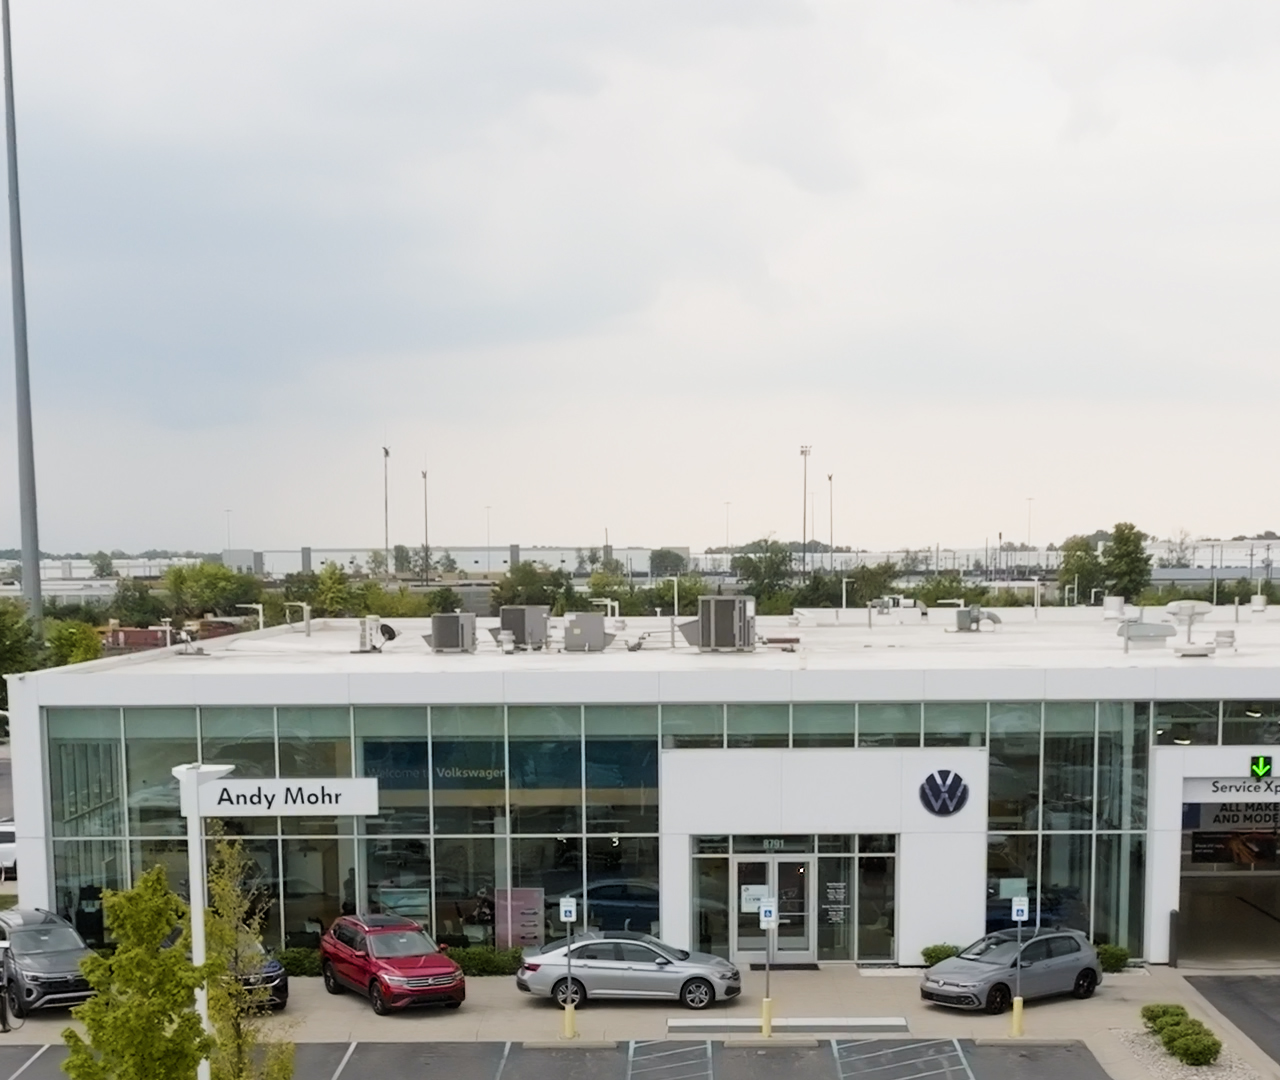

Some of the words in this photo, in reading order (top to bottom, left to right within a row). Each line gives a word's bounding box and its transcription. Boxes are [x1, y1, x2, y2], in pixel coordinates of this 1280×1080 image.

[1211, 780, 1261, 793] Service
[217, 786, 275, 809] Andy
[284, 786, 342, 804] Mohr
[1220, 803, 1242, 812] ALL
[1213, 814, 1240, 823] AND
[763, 839, 785, 849] 8791
